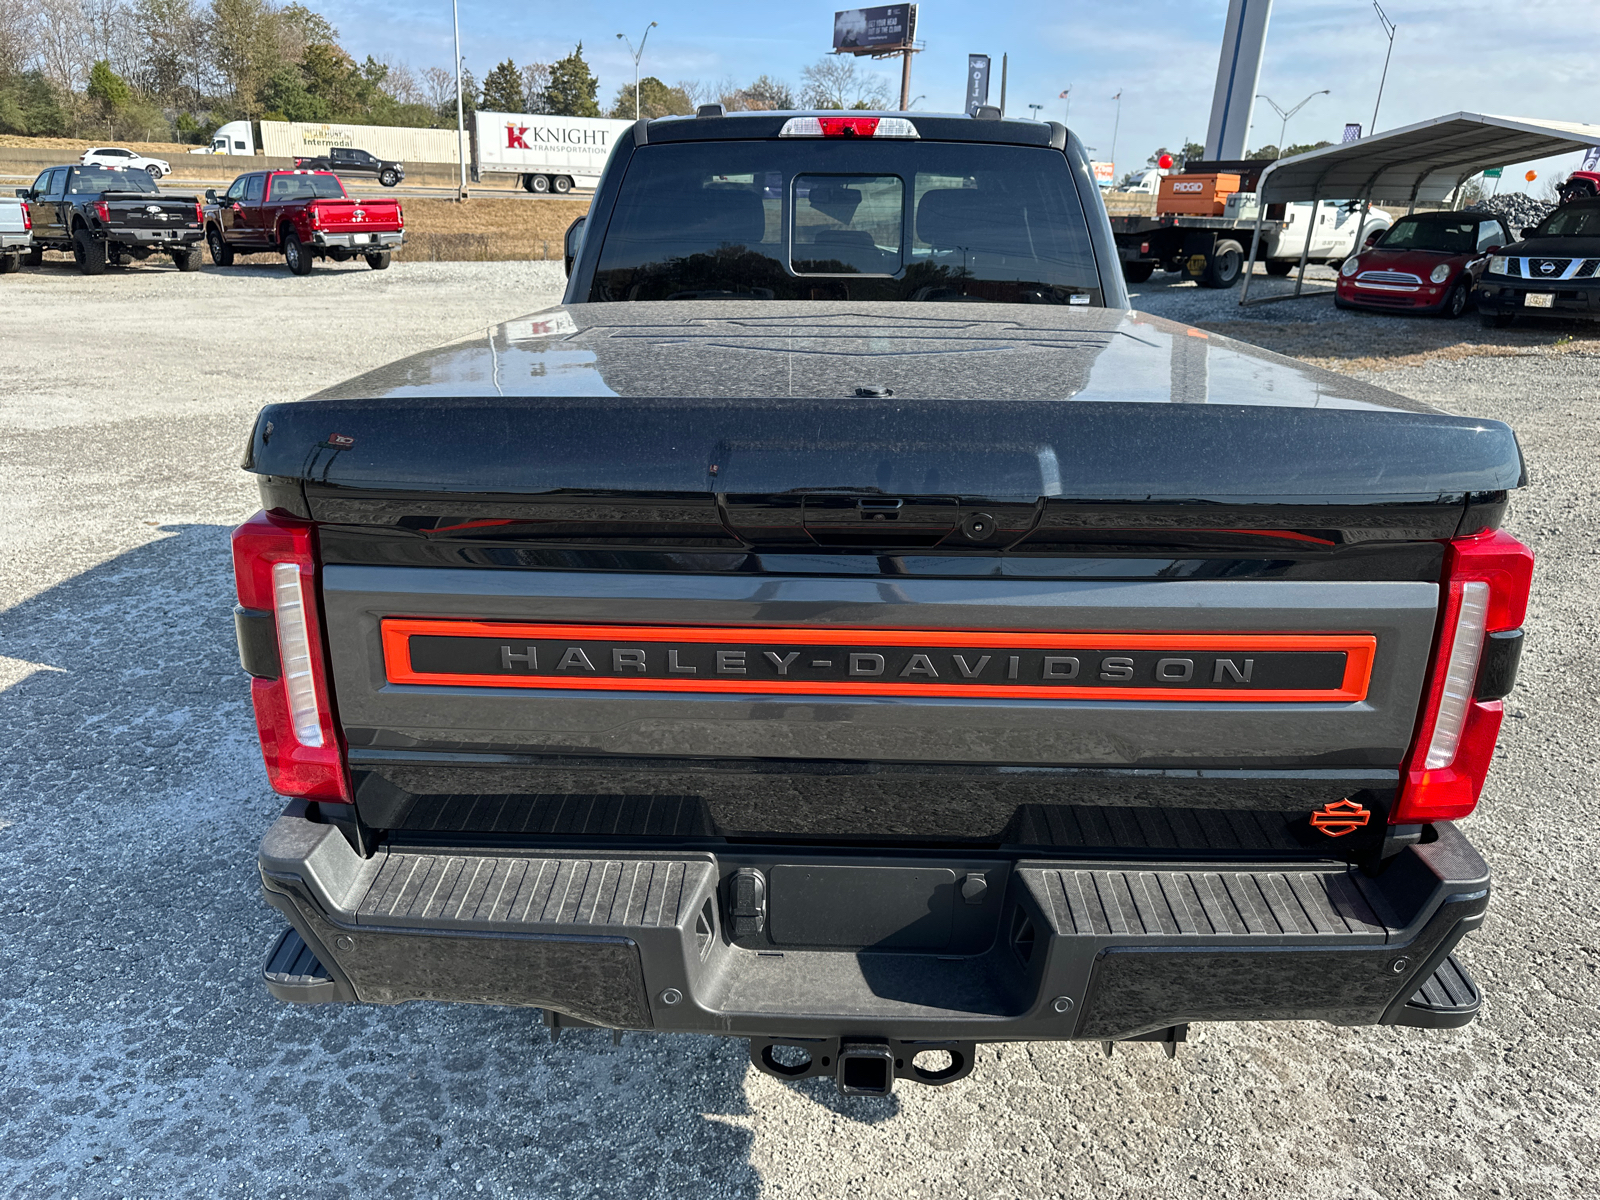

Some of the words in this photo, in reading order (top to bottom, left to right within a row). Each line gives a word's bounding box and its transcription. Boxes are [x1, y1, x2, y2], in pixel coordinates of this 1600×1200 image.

[533, 126, 610, 146] KNIGHT
[303, 138, 353, 147] Intermodal
[533, 144, 607, 155] TRANSPORTATION
[1173, 182, 1204, 192] RIDGID
[500, 645, 1254, 683] HARLEY-DAVIDSON
